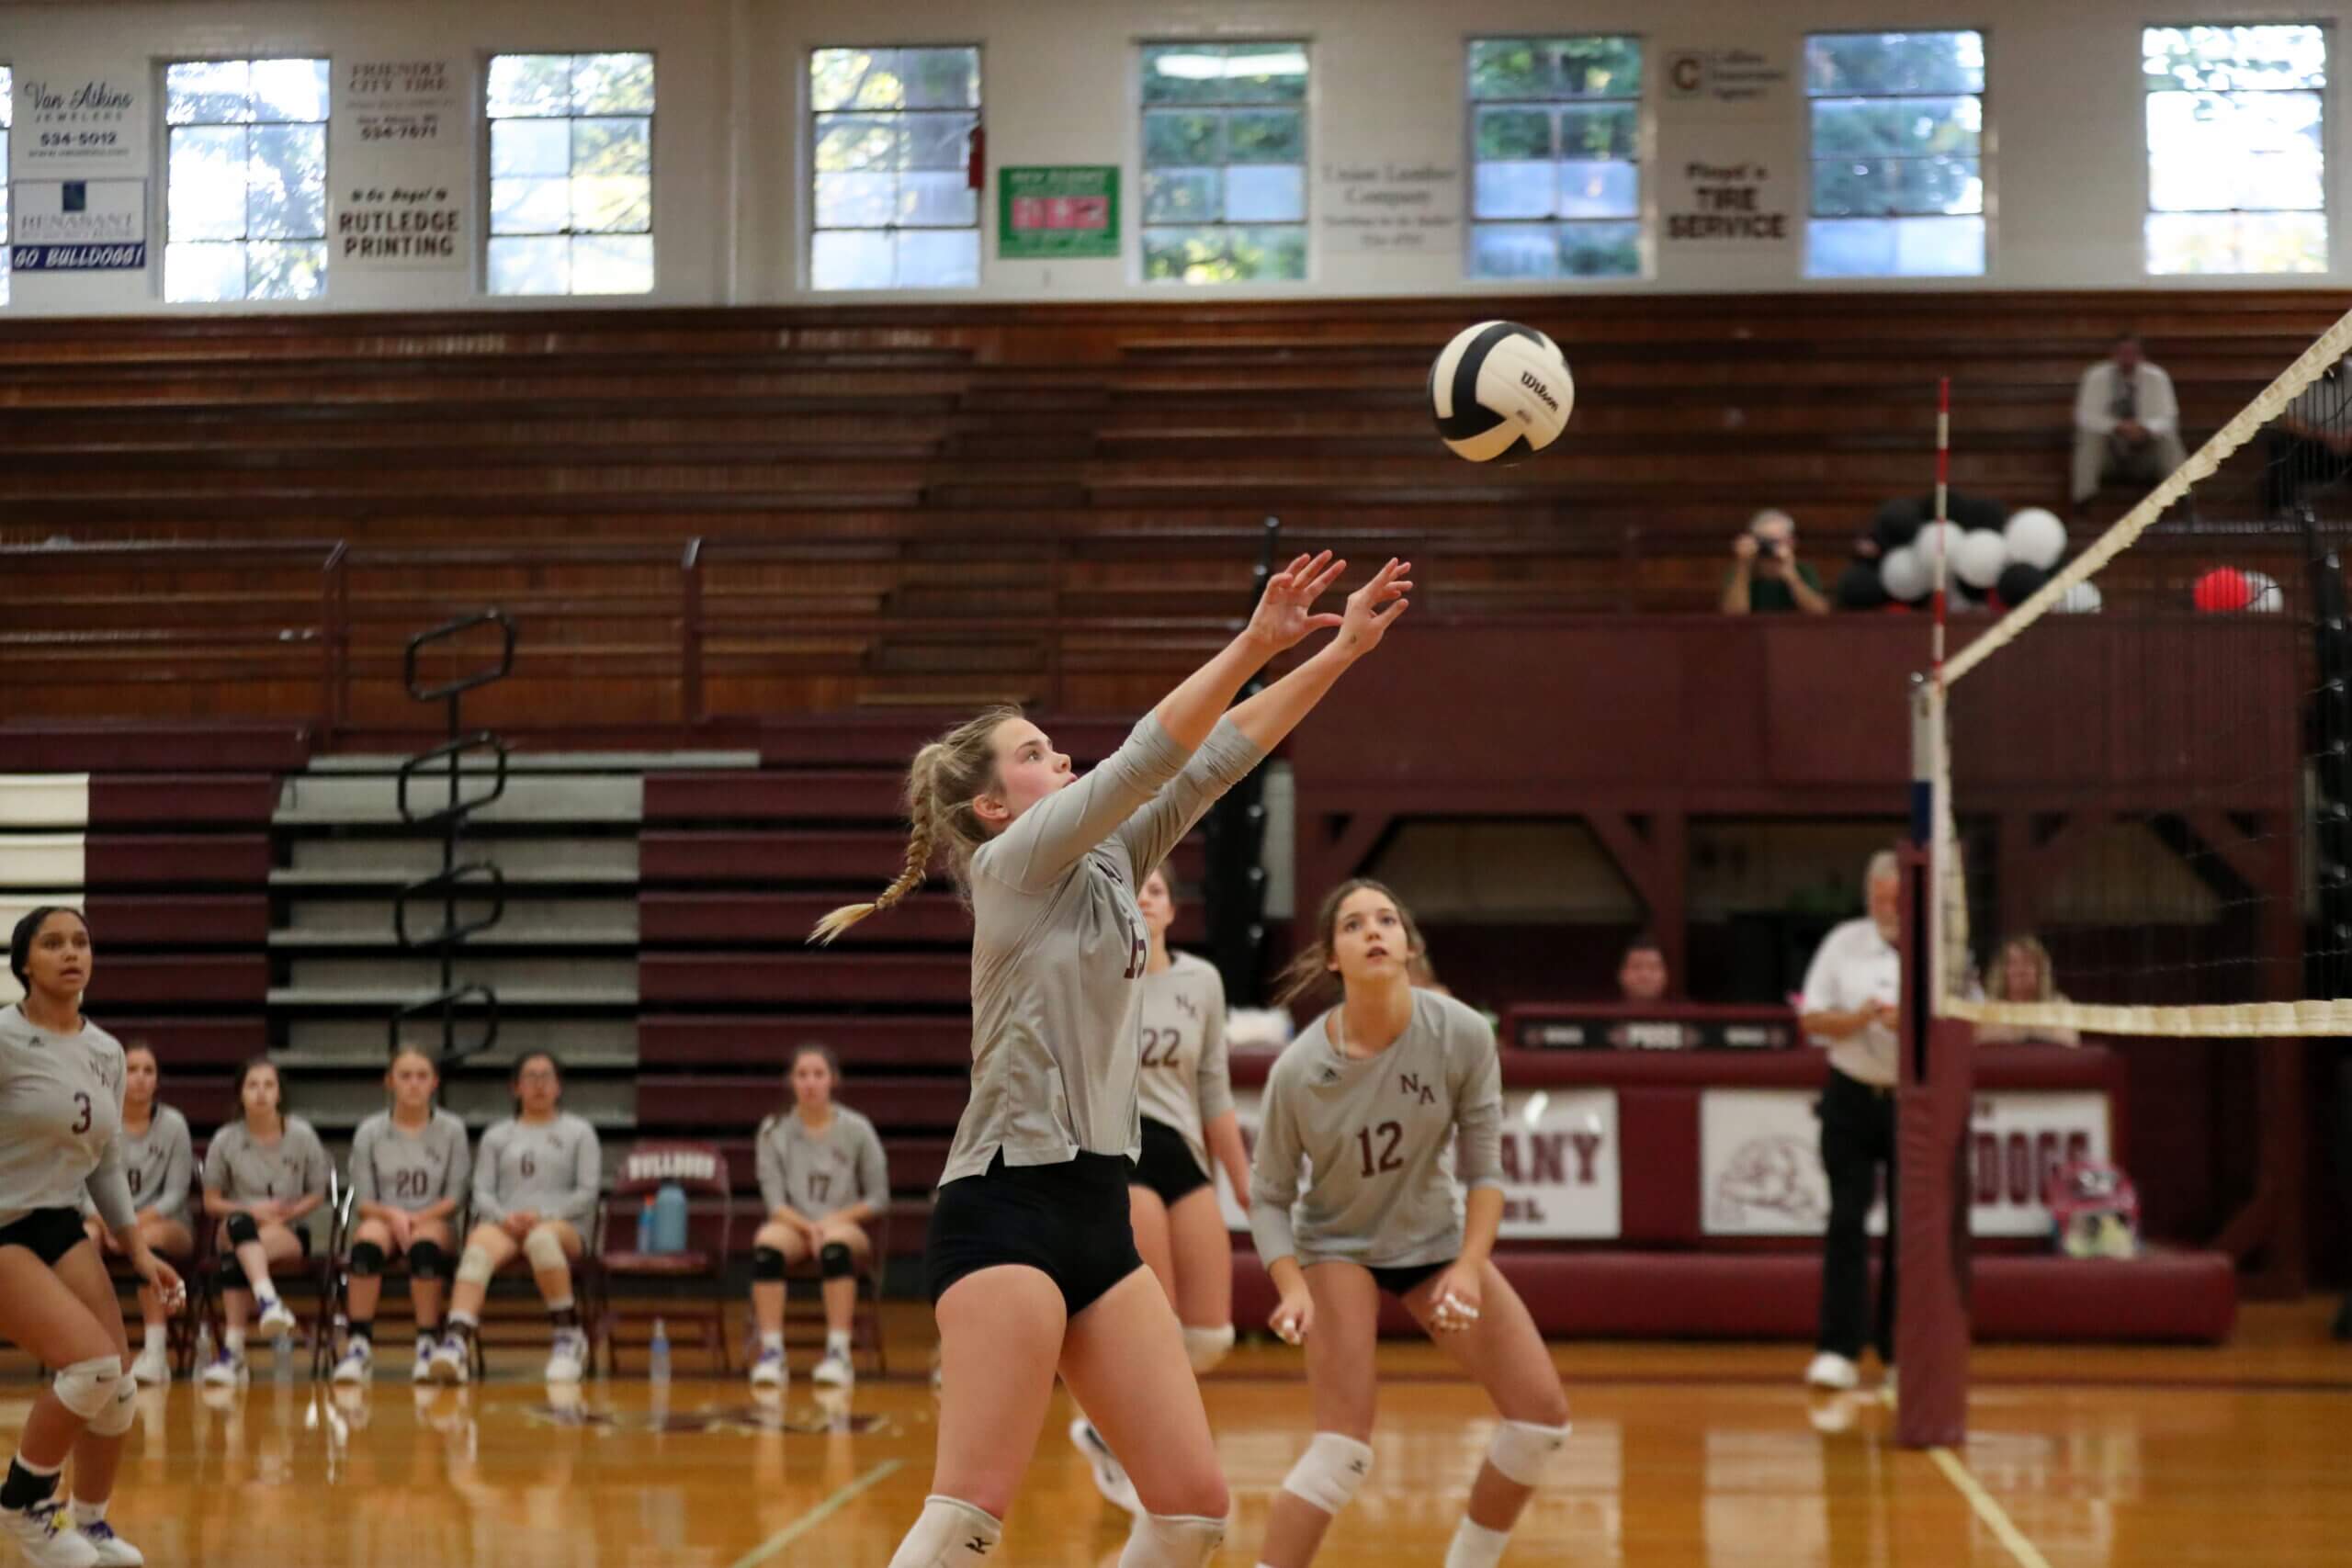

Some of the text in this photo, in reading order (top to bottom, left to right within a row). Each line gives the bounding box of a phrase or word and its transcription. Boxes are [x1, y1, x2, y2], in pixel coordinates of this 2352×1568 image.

[24, 80, 64, 110] Van
[40, 131, 118, 146] 534-5012
[1696, 188, 1756, 210] TIRE
[339, 210, 459, 233] RUTLEDGE
[1668, 214, 1788, 238] SERVICE
[344, 235, 454, 257] PRINTING
[1521, 370, 1559, 412] Wilson
[1142, 1028, 1182, 1068] 22
[71, 1092, 92, 1135] 3
[1356, 1120, 1404, 1179] 12
[520, 1153, 536, 1178] 6
[396, 1168, 428, 1198] 20
[808, 1173, 833, 1202] 17
